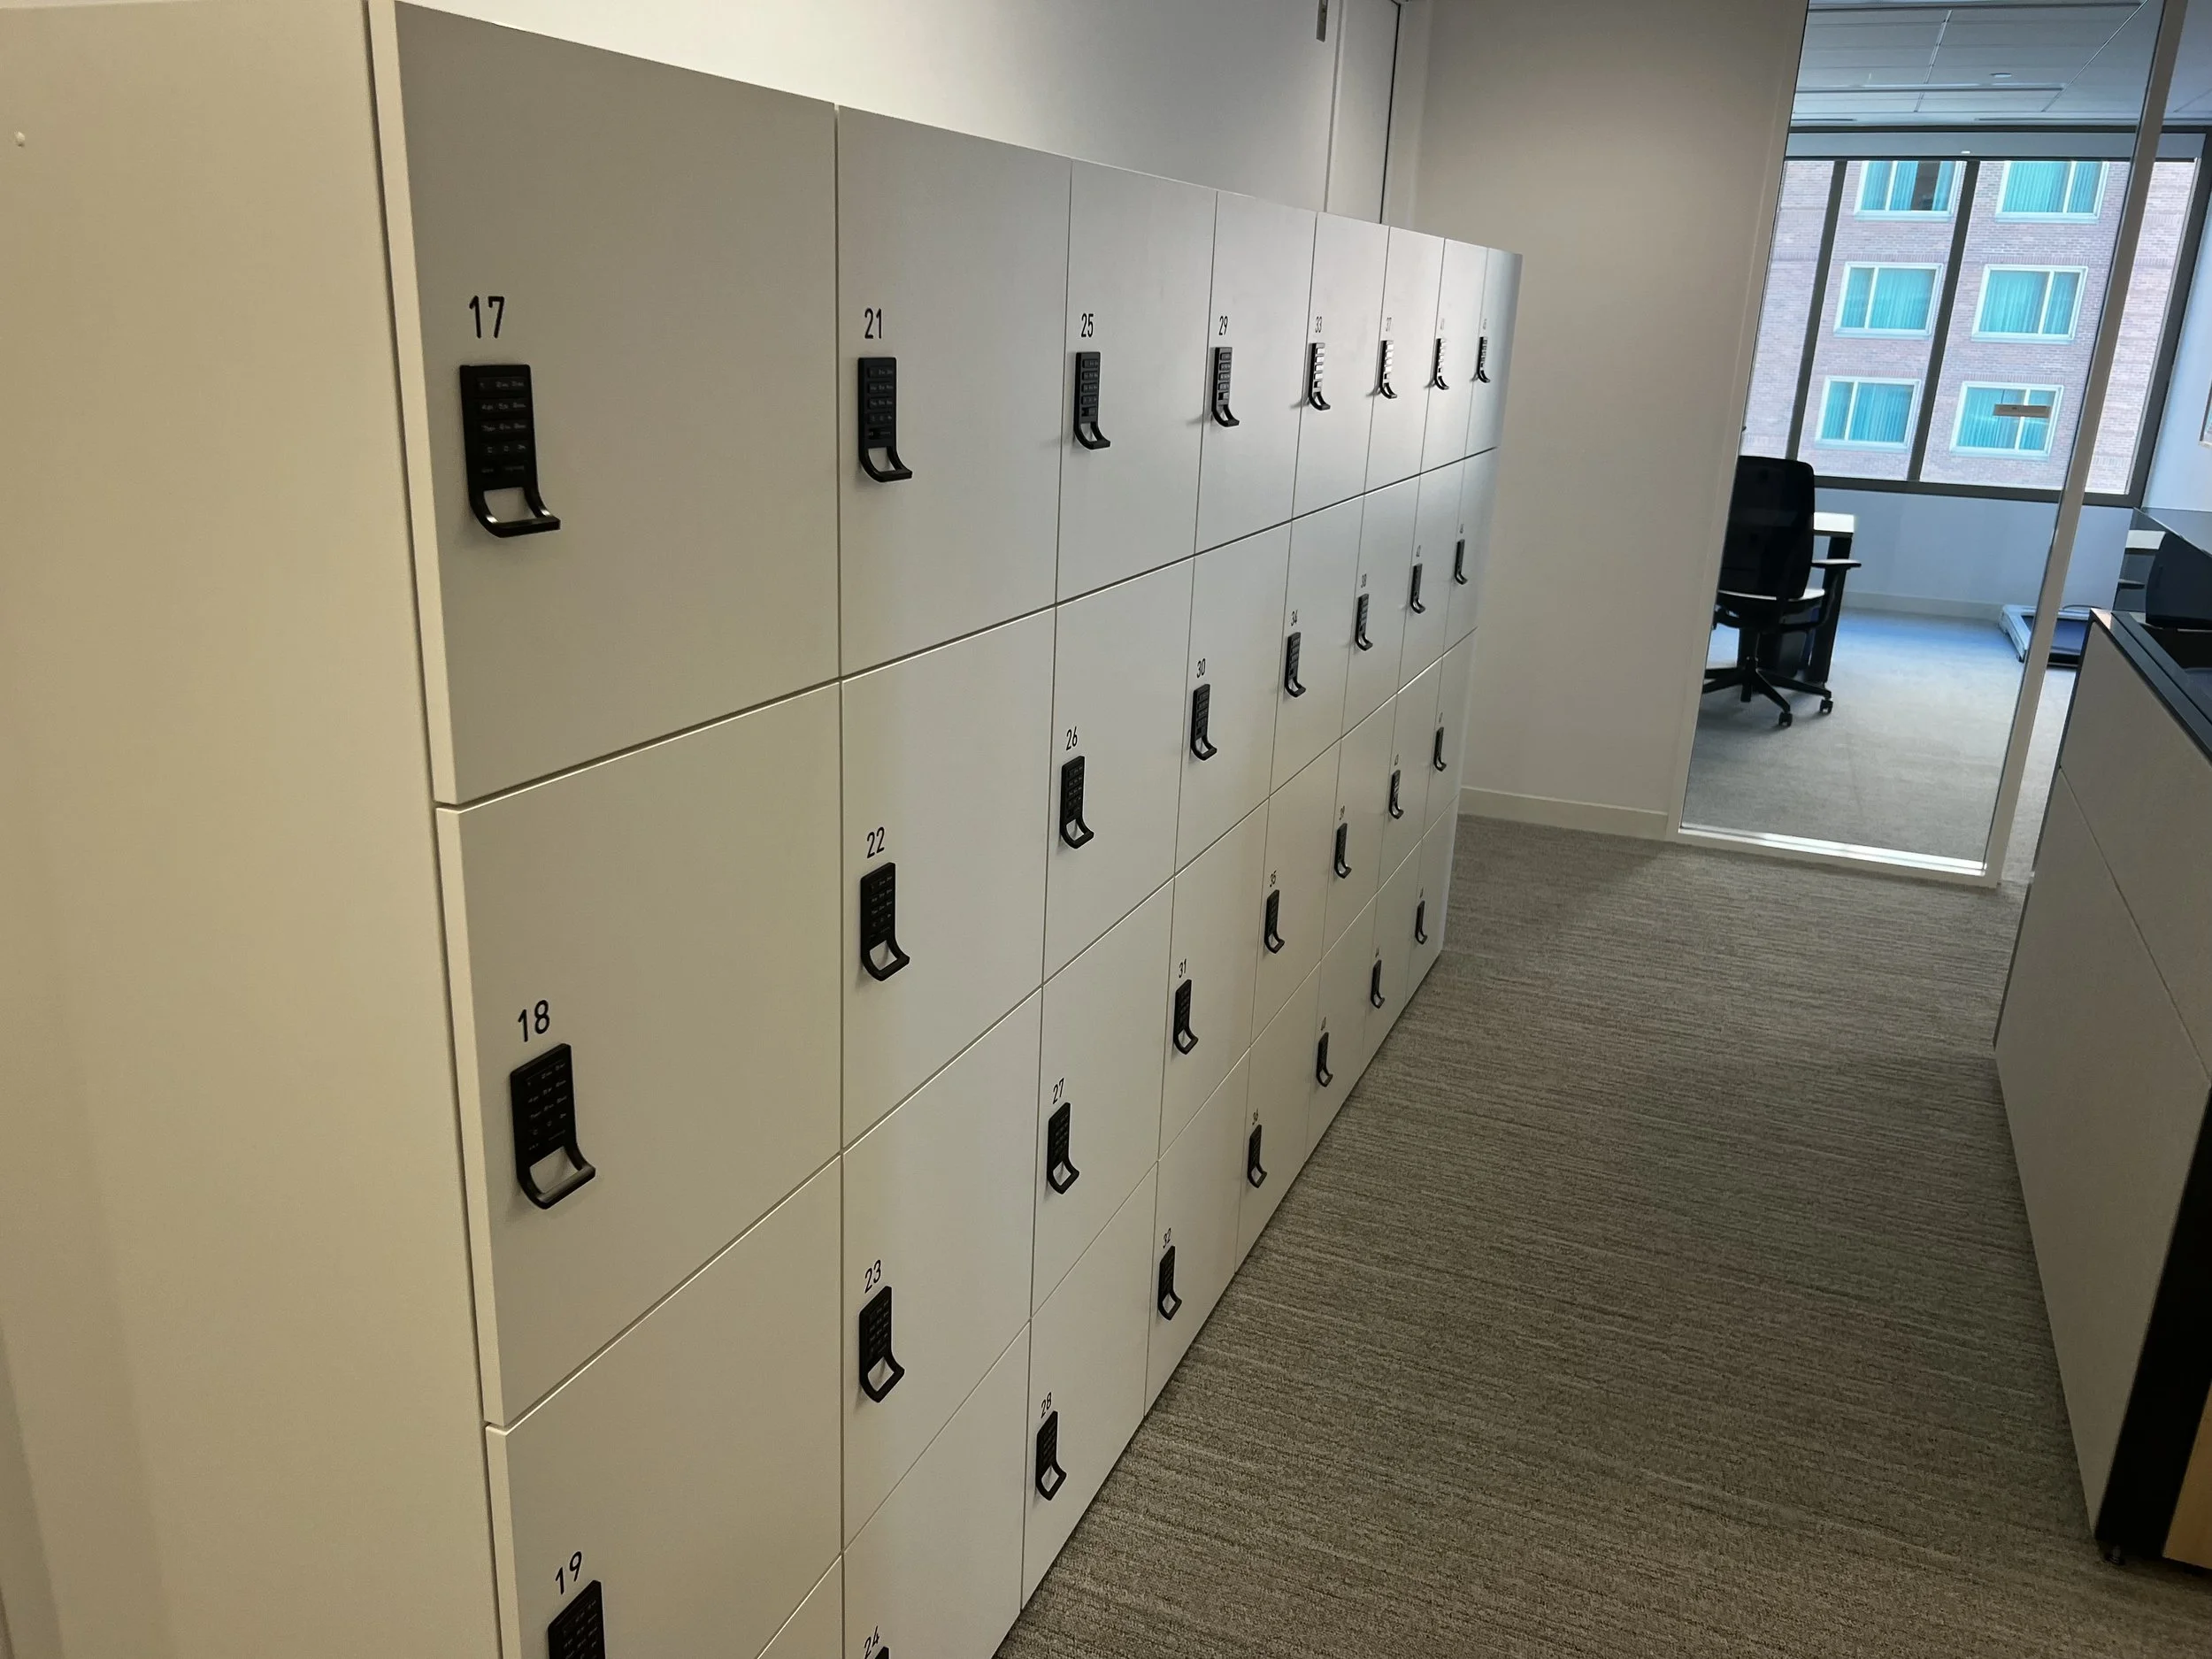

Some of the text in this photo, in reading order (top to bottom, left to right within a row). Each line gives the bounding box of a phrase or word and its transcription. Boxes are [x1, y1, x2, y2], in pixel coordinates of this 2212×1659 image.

[468, 295, 505, 339] 17
[864, 307, 882, 340] 21
[1080, 312, 1094, 338] 25
[1218, 315, 1228, 336] 29
[1315, 316, 1323, 334] 33
[1290, 609, 1298, 627] 34
[1196, 657, 1206, 679] 30
[1065, 726, 1078, 751] 26
[866, 826, 885, 859] 22
[1179, 958, 1187, 979] 31
[517, 999, 550, 1043] 18
[1052, 1077, 1064, 1105] 27
[1162, 1227, 1171, 1249] 32
[864, 1259, 881, 1294] 23
[1041, 1391, 1052, 1419] 28
[555, 1551, 582, 1595] 19
[864, 1625, 880, 1659] 24
